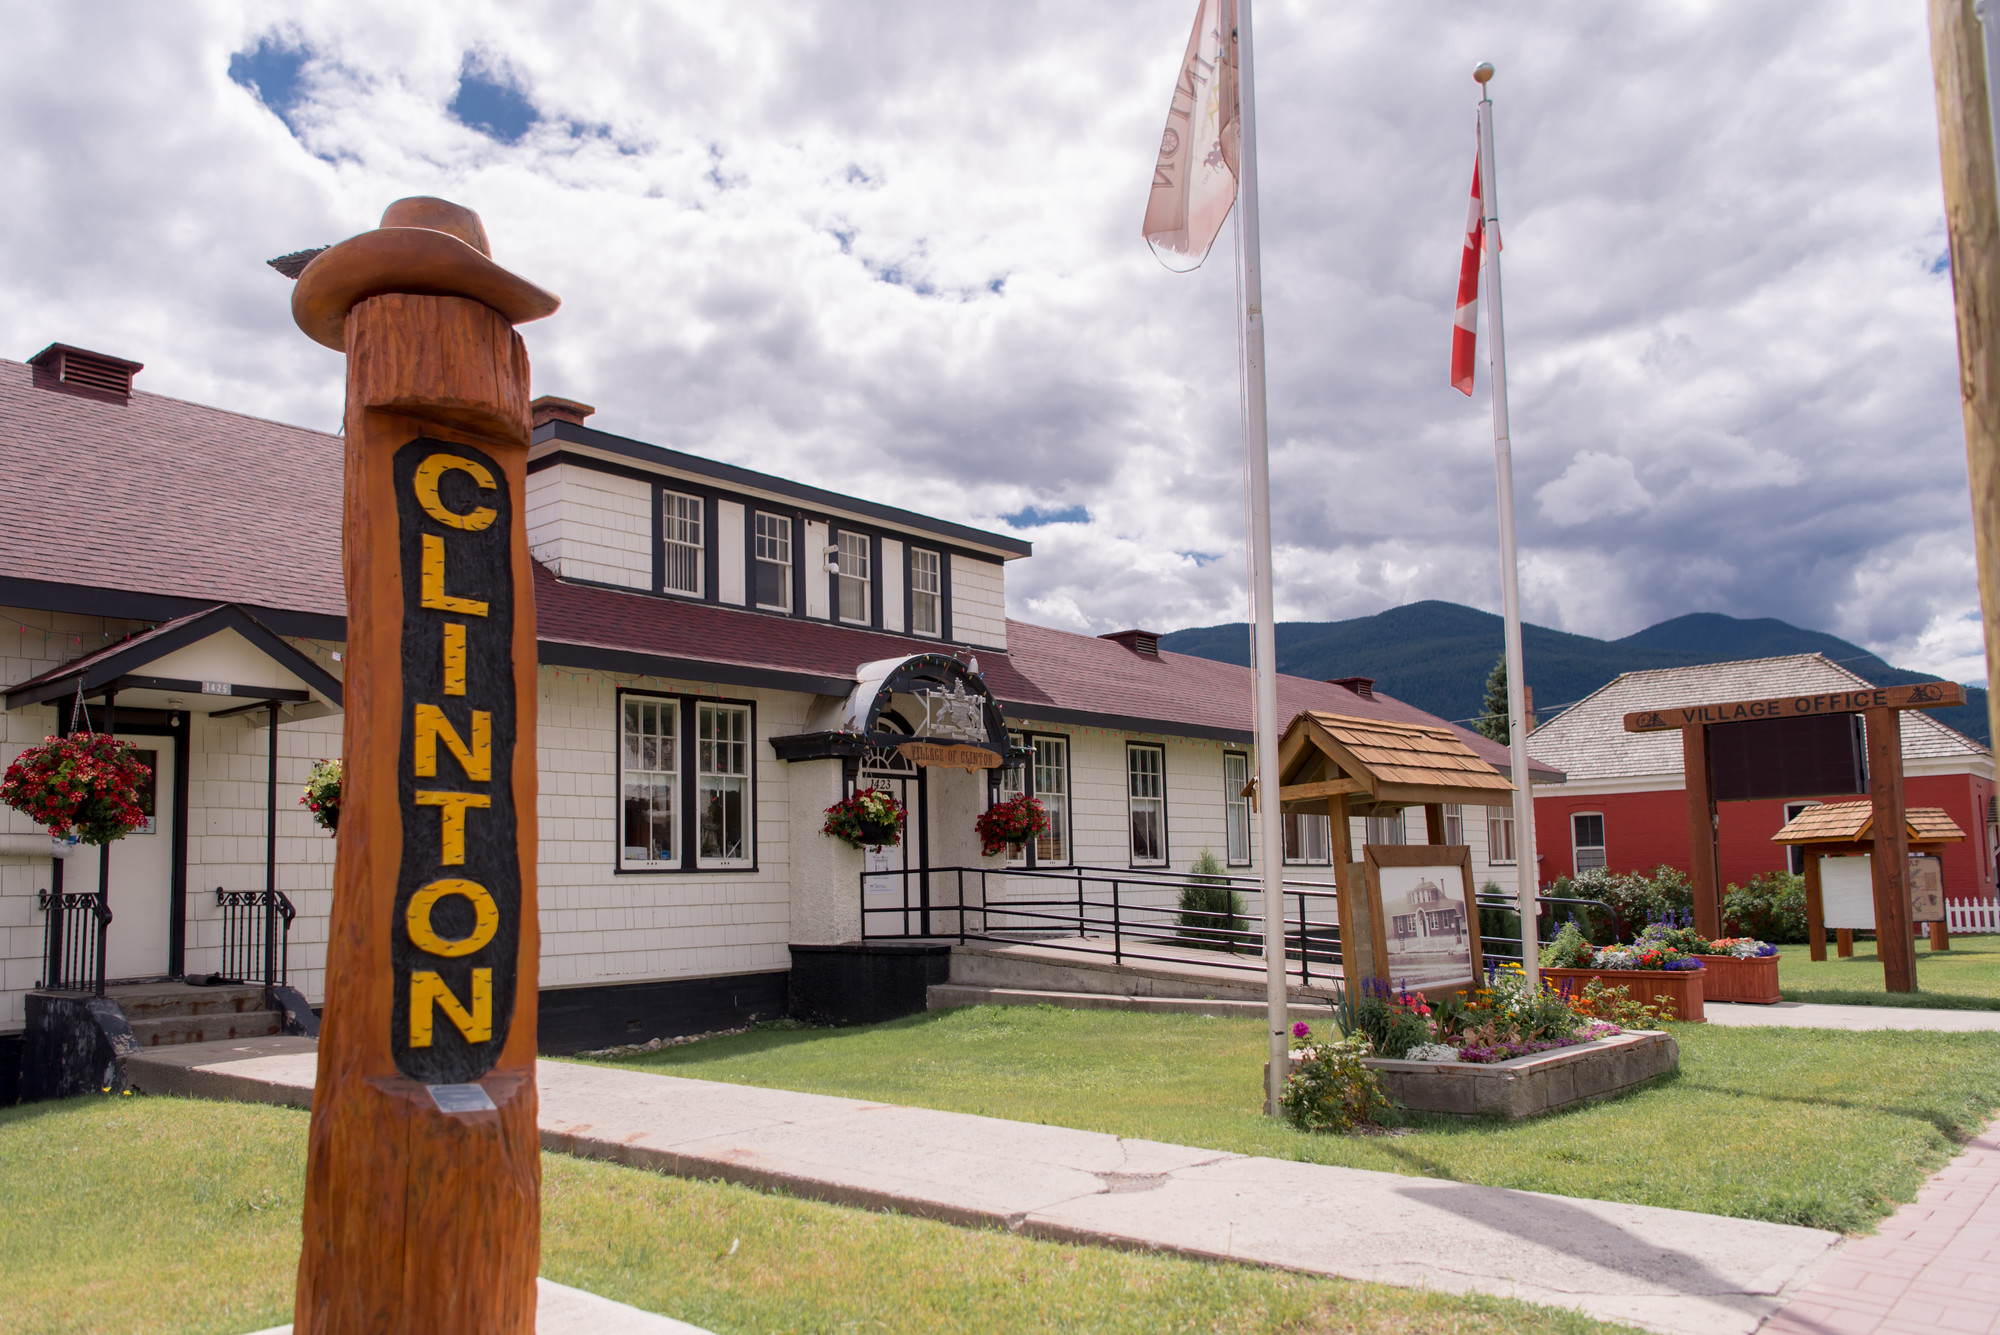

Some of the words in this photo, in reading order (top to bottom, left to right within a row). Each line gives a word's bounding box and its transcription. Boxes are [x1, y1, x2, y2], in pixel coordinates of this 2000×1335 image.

[206, 682, 227, 693] 1425
[1682, 701, 1781, 723] VILLAGE
[1795, 691, 1888, 712] OFFICE
[406, 453, 499, 1048] CLINTON
[911, 745, 944, 762] VILLAGE
[947, 750, 957, 762] OF
[960, 750, 993, 766] CLINTON
[871, 779, 891, 790] 1423
